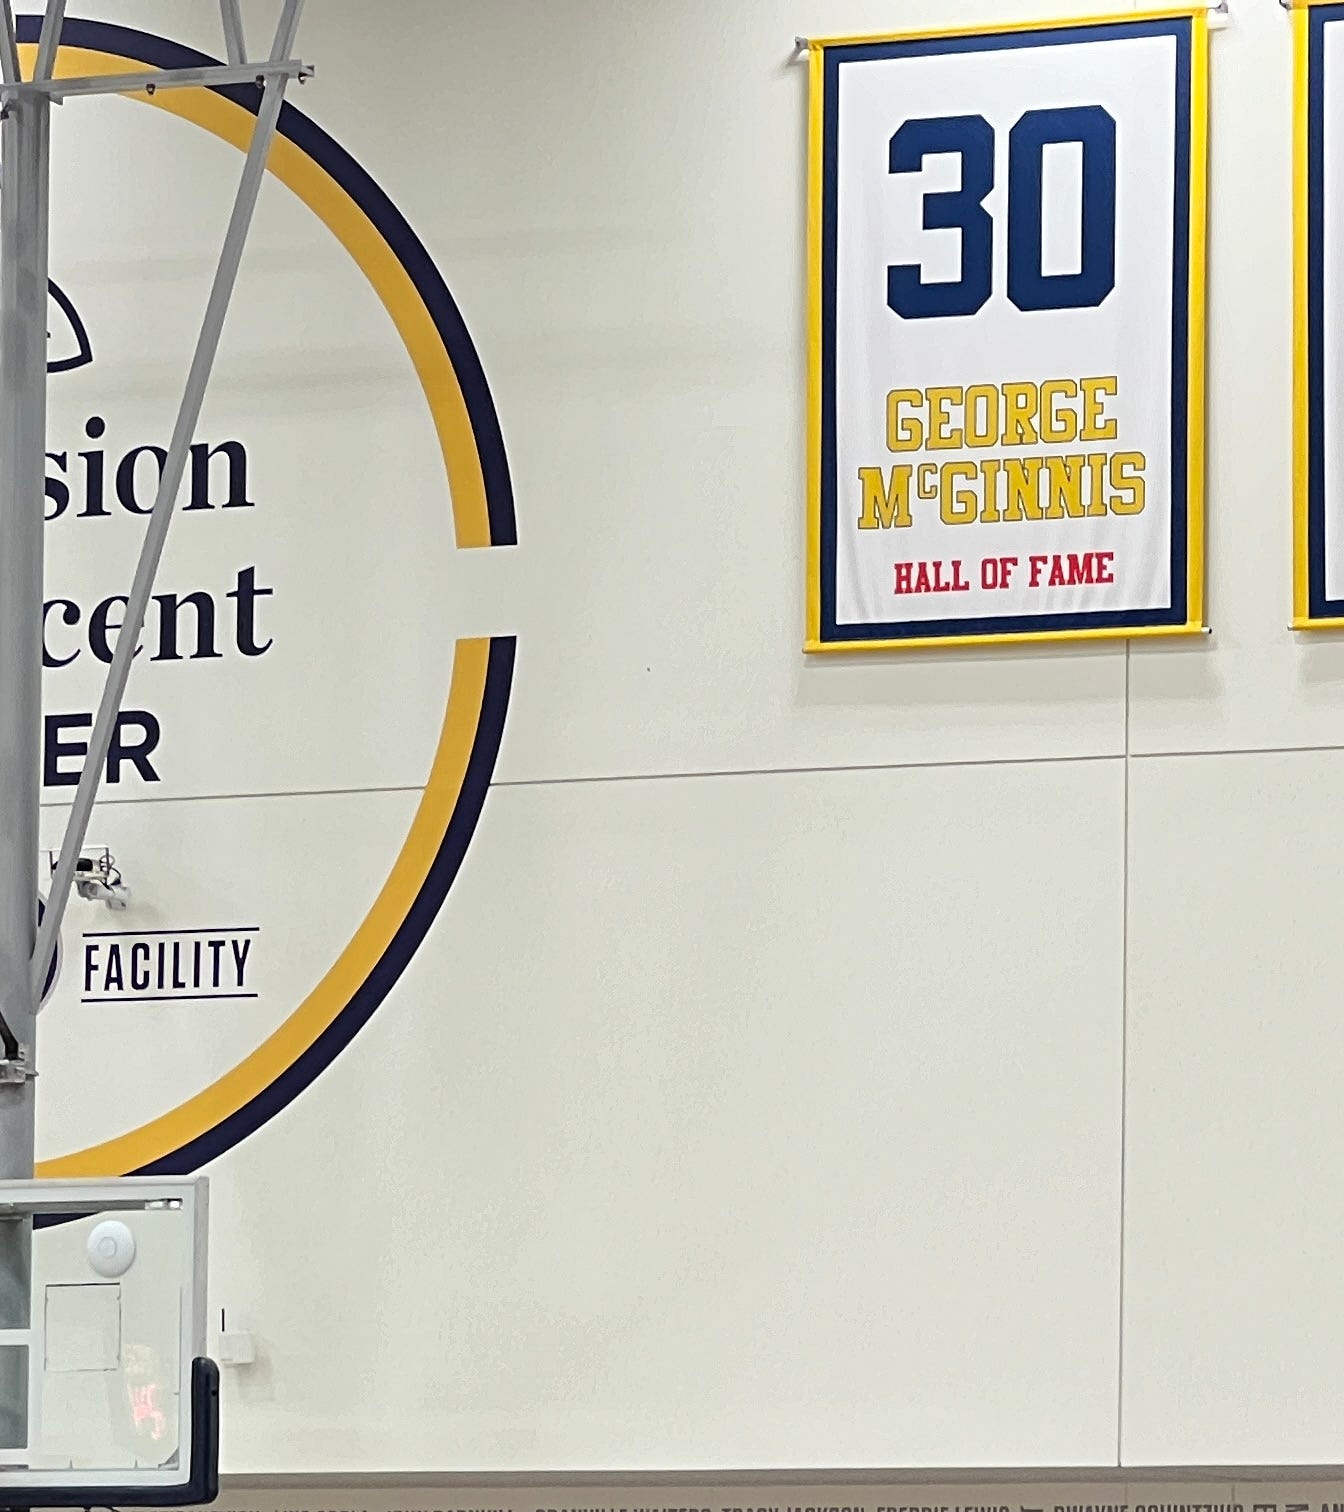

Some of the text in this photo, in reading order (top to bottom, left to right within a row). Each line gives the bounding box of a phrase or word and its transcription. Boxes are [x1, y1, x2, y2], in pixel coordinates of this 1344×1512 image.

[886, 105, 1116, 320] 30
[886, 376, 1118, 452] GEORGE
[893, 551, 1114, 595] HALL OF FAME
[83, 938, 251, 993] FACILITY
